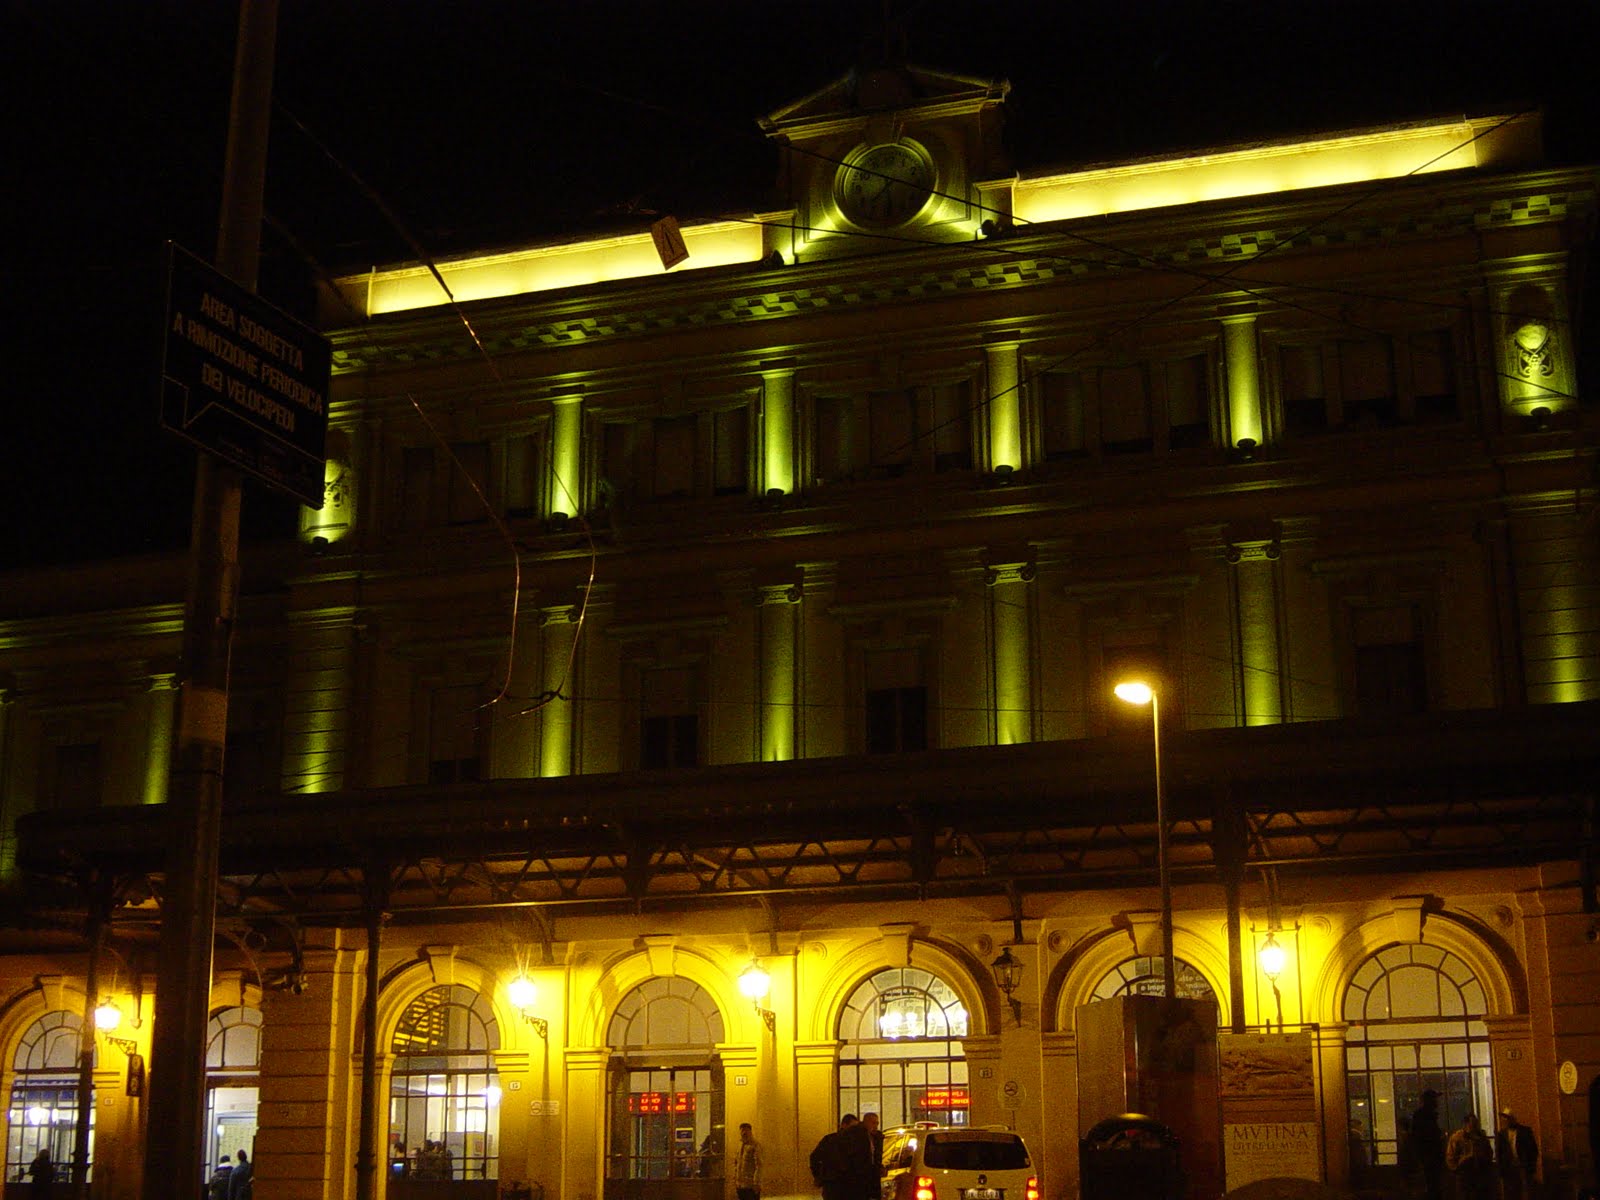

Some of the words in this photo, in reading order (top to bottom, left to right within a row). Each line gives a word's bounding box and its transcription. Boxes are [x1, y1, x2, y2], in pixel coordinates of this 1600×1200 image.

[172, 312, 185, 336] A
[187, 319, 258, 379] RIMOZIONE
[260, 361, 323, 416] PERIODICA
[200, 291, 237, 332] AREA
[239, 314, 304, 372] SOGGETTA
[201, 361, 223, 392] DEI
[226, 376, 296, 432] VELOCIPEDI
[1233, 1125, 1308, 1140] MVTINA
